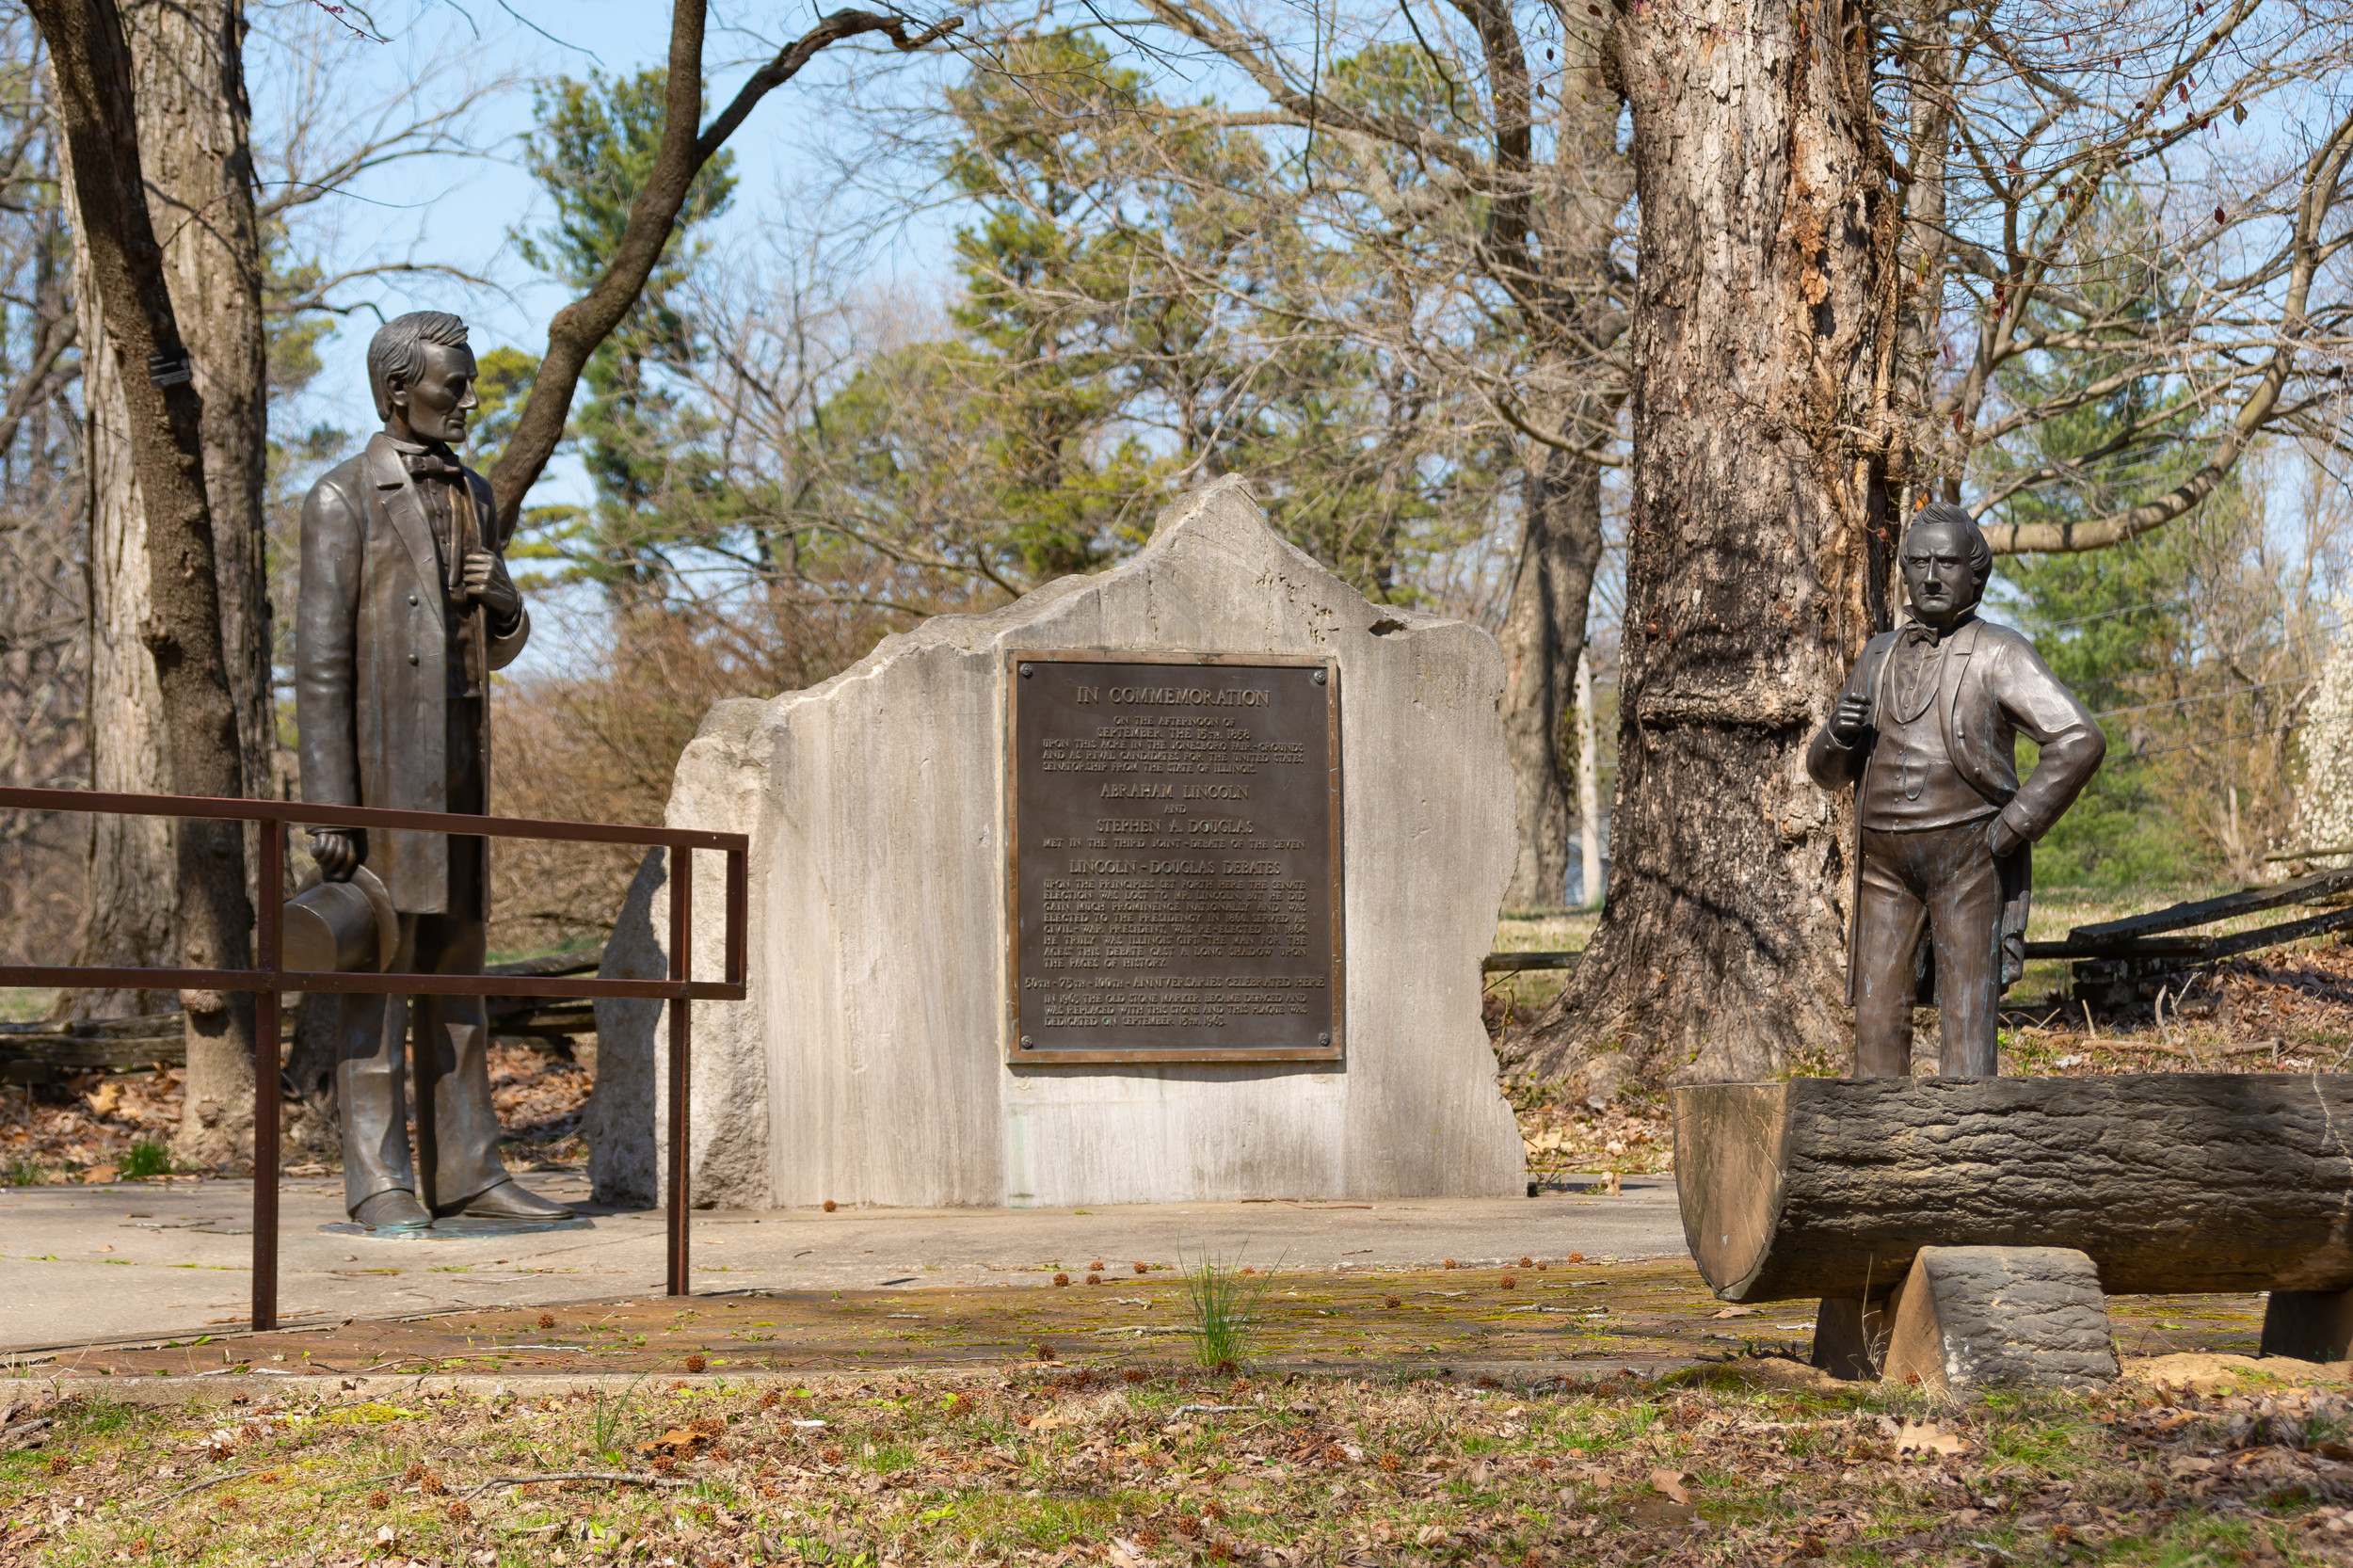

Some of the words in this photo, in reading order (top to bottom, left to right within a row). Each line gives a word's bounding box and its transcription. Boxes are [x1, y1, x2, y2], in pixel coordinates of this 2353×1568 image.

[1077, 686, 1099, 703] IN
[1109, 687, 1270, 707] COMMEMORATION
[1113, 716, 1128, 726] ON
[1134, 716, 1154, 726] THE
[1159, 716, 1219, 727] AFTERNOON
[1224, 718, 1236, 727] OF
[1097, 728, 1162, 739] SEPTEMBER
[1170, 728, 1192, 739] THE
[1042, 739, 1069, 749] UPON
[1075, 739, 1096, 749] THIS
[1100, 740, 1127, 750] ACRE
[1130, 741, 1142, 750] IN
[1147, 741, 1166, 750] THE
[1171, 741, 1226, 751] JONESBORO
[1043, 750, 1064, 760] AND
[1069, 751, 1081, 760] AS
[1086, 751, 1116, 760] RIVAL
[1119, 751, 1179, 761] CANDIDATES
[1184, 752, 1204, 762] FOR
[1209, 753, 1228, 762] THE
[1233, 753, 1269, 763] UNITED
[1273, 754, 1304, 763] STATES
[1043, 761, 1107, 772] SENATORSHIP
[1112, 761, 1139, 773] FROM
[1144, 762, 1162, 773] THE
[1167, 762, 1193, 773] STATE
[1197, 763, 1209, 773] OF
[1100, 782, 1174, 799] ABRAHAM
[1183, 784, 1249, 800] LINCOLN
[1164, 804, 1186, 814] AND
[1096, 818, 1161, 834] STEPHEN
[1169, 819, 1183, 834] A.
[1188, 819, 1254, 834] DOUGLAS
[1043, 838, 1064, 848] MET
[1069, 838, 1081, 848] IN
[1087, 838, 1108, 848] THE
[1113, 839, 1145, 848] THIRD
[1230, 840, 1243, 849] OF
[1249, 840, 1269, 850] THE
[1273, 840, 1305, 850] SEVEN
[1069, 859, 1137, 874] LINCOLN
[1149, 859, 1215, 875] DOUGLAS
[1223, 860, 1281, 875] DEBATES
[1044, 880, 1070, 889] UPON
[1076, 880, 1095, 889] THE
[1099, 880, 1155, 889] PRINCIPLES
[1160, 880, 1176, 889] SET
[1181, 880, 1213, 889] FORTH
[1218, 880, 1244, 890] HERE
[1249, 880, 1268, 890] THE
[1273, 881, 1305, 890] SENATE
[1044, 890, 1092, 901] ELECTION
[1099, 891, 1119, 901] WAS
[1125, 891, 1148, 901] LOST
[1154, 891, 1168, 901] TO
[1247, 891, 1264, 901] BUT
[1270, 891, 1282, 902] HE
[1288, 892, 1305, 902] DID
[1043, 903, 1069, 912] GAIN
[1076, 903, 1105, 912] MUCH
[1112, 903, 1179, 912] PROMINENCE
[1187, 903, 1250, 912] NATIONALLY
[1257, 903, 1279, 912] AND
[1288, 904, 1306, 913] WAS
[1043, 913, 1088, 923] ELECTED
[1094, 913, 1108, 923] TO
[1113, 913, 1133, 923] THE
[1139, 914, 1201, 923] PRESIDENCY
[1208, 914, 1220, 923] IN
[1252, 914, 1289, 923] SERVED
[1294, 914, 1306, 923] AS
[1173, 924, 1193, 935] WAS
[1266, 925, 1278, 935] IN
[1044, 936, 1058, 946] HE
[1064, 936, 1096, 946] TRULY
[1102, 936, 1123, 946] WAS
[1233, 936, 1255, 946] MAN
[1261, 936, 1281, 946] FOR
[1288, 936, 1306, 946] THE
[1078, 947, 1100, 957] THIS
[1106, 947, 1144, 957] DEBATE
[1149, 947, 1175, 957] CAST
[1180, 947, 1188, 957] A
[1194, 947, 1222, 957] LONG
[1229, 947, 1273, 957] SHADOW
[1280, 947, 1306, 957] UPON
[1044, 958, 1064, 969] THE
[1069, 958, 1099, 969] PAGES
[1104, 958, 1118, 969] OF
[1133, 976, 1223, 988] ANNIVERSARIES
[1225, 976, 1291, 988] CELEBRATED
[1295, 976, 1324, 987] HERE
[1044, 993, 1056, 1004] IN
[1083, 993, 1103, 1004] THE
[1105, 993, 1125, 1004] OLD
[1129, 993, 1158, 1004] STONE
[1160, 993, 1201, 1003] MARKER
[1205, 993, 1241, 1003] BECAME
[1244, 993, 1282, 1003] DEFACED
[1286, 993, 1306, 1003] AND
[1044, 1005, 1064, 1016] WAS
[1067, 1005, 1114, 1016] REPLACED
[1118, 1004, 1144, 1016] WITH
[1147, 1004, 1167, 1016] THIS
[1171, 1004, 1199, 1015] STONE
[1203, 1004, 1224, 1015] AND
[1227, 1004, 1248, 1015] THIS
[1252, 1004, 1285, 1016] PLAQUE
[1289, 1004, 1307, 1015] WAS
[1045, 1016, 1097, 1028] DEDICATED
[1101, 1016, 1117, 1027] ON
[1123, 1016, 1174, 1027] SEPTEMBER
